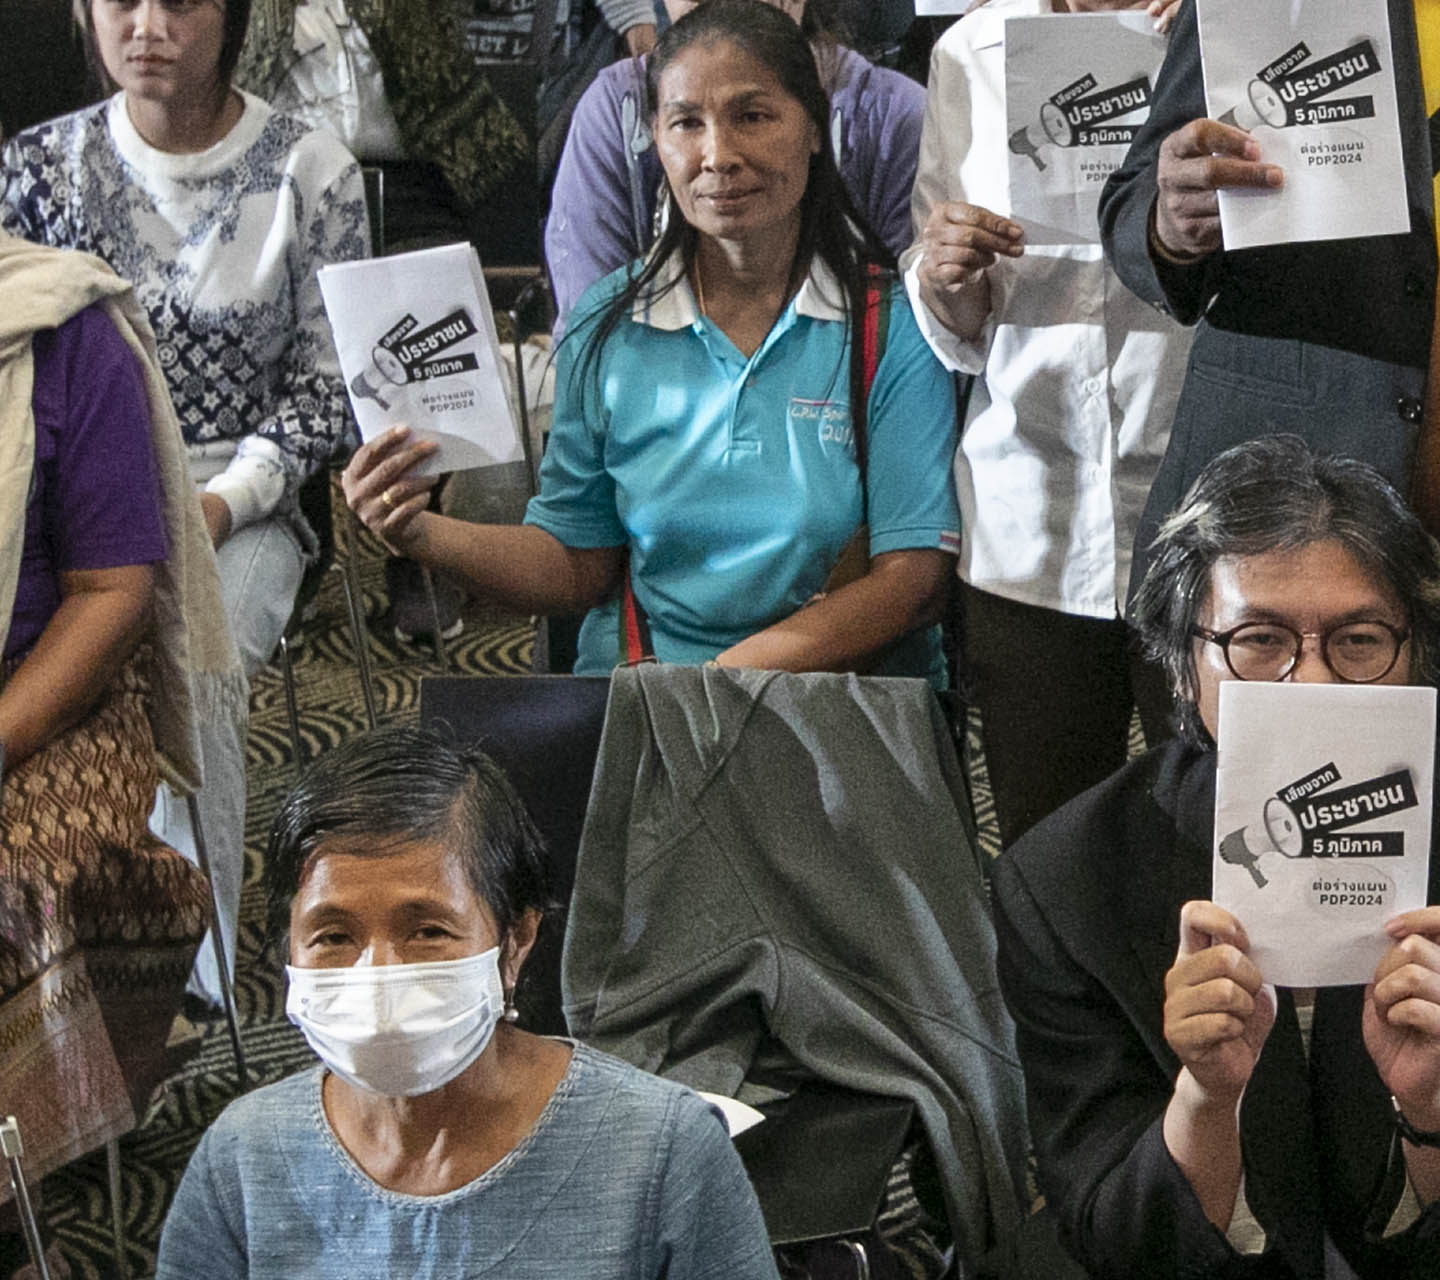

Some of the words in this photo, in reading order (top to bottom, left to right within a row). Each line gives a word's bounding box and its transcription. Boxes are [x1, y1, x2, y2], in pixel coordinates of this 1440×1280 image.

[1264, 49, 1306, 82] เสียงจาก
[1280, 55, 1369, 102] ประชาชน
[1068, 88, 1146, 125] ประชาชน
[1307, 104, 1357, 124] ภูมิภาค
[1079, 131, 1088, 143] 5
[1090, 129, 1132, 146] ภูมิภาค
[1299, 140, 1365, 156] ต่อร่างแผน
[1307, 152, 1363, 167] PDP2024
[399, 319, 468, 364] ประชาชน
[423, 360, 464, 379] ภูมิภาค
[429, 398, 475, 414] PDP2024
[1284, 770, 1335, 803] เสียงจาก
[1300, 784, 1405, 829] ประชาชน
[1327, 837, 1383, 857] ภูมิภาค
[1312, 877, 1387, 892] ต่อร่างแผน
[1320, 895, 1383, 905] PDP2024
